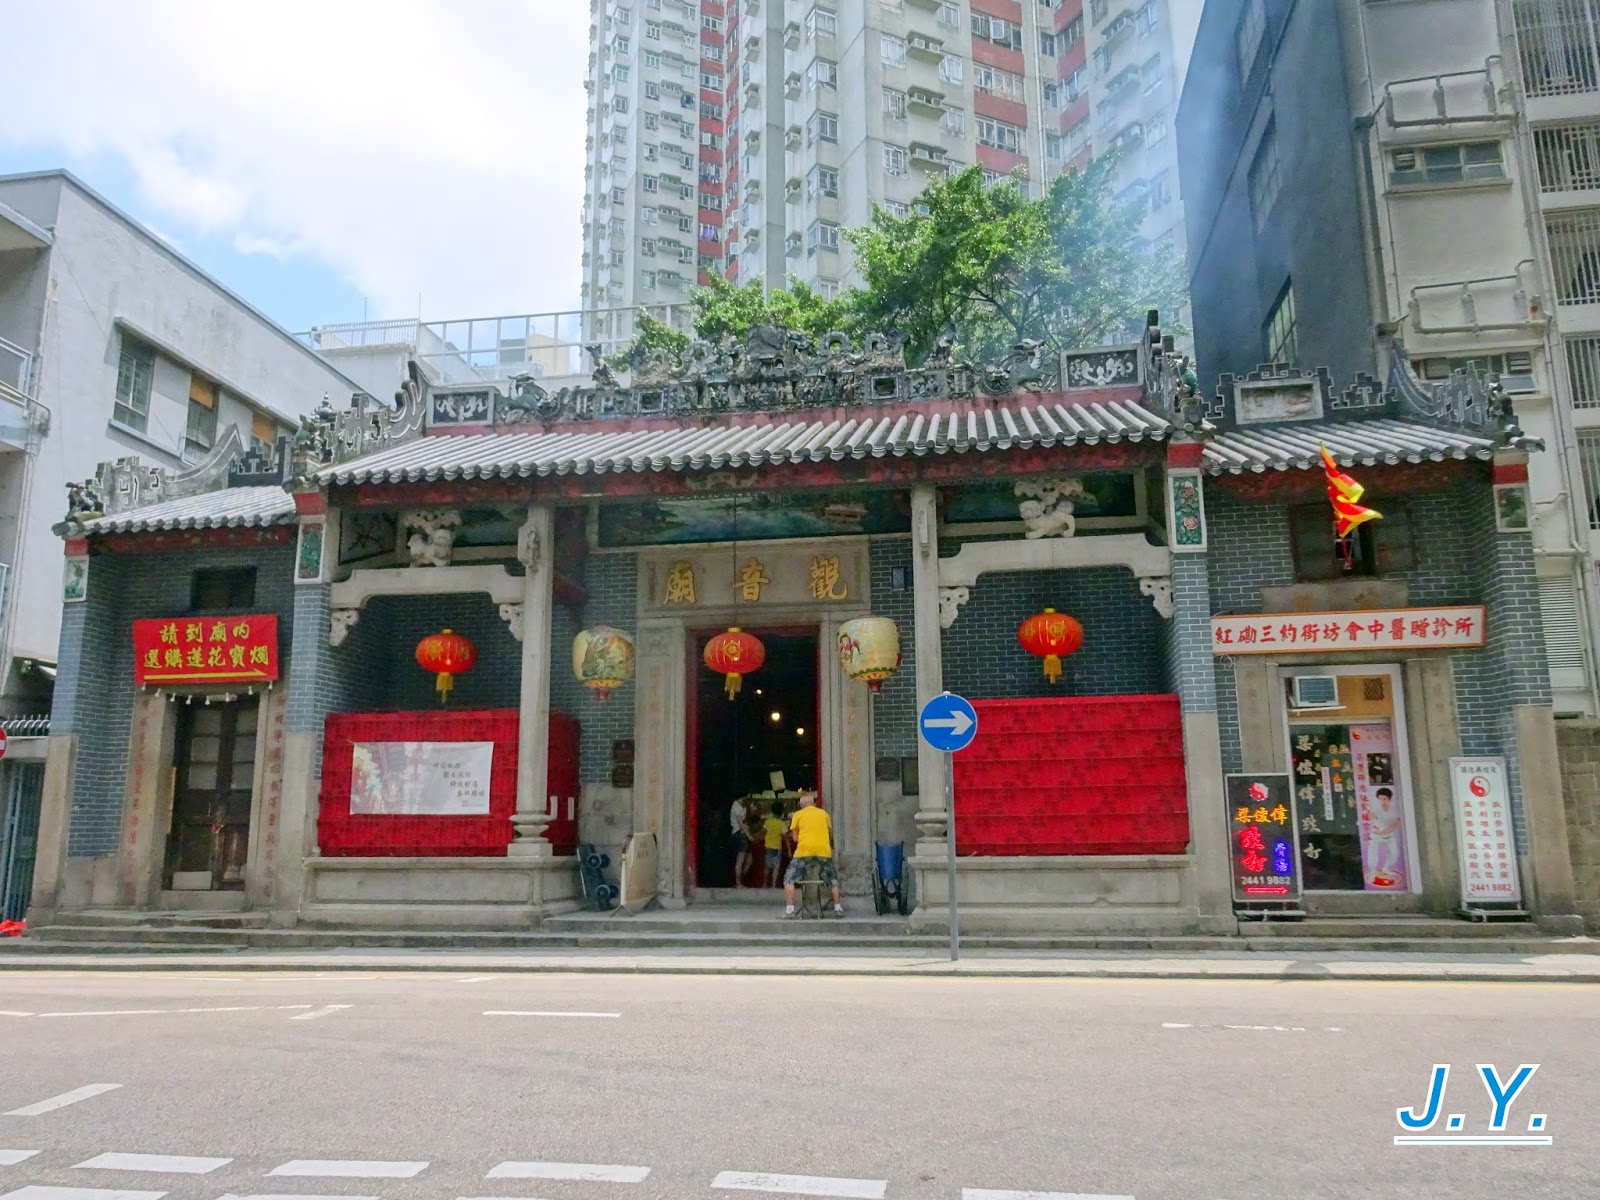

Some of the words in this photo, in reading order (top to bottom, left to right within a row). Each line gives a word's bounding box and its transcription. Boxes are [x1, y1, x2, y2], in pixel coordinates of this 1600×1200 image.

[1214, 616, 1475, 645] 紅磡三約街坊會中醫贈診所
[1241, 876, 1265, 885] 2441
[1470, 884, 1490, 892] 2441
